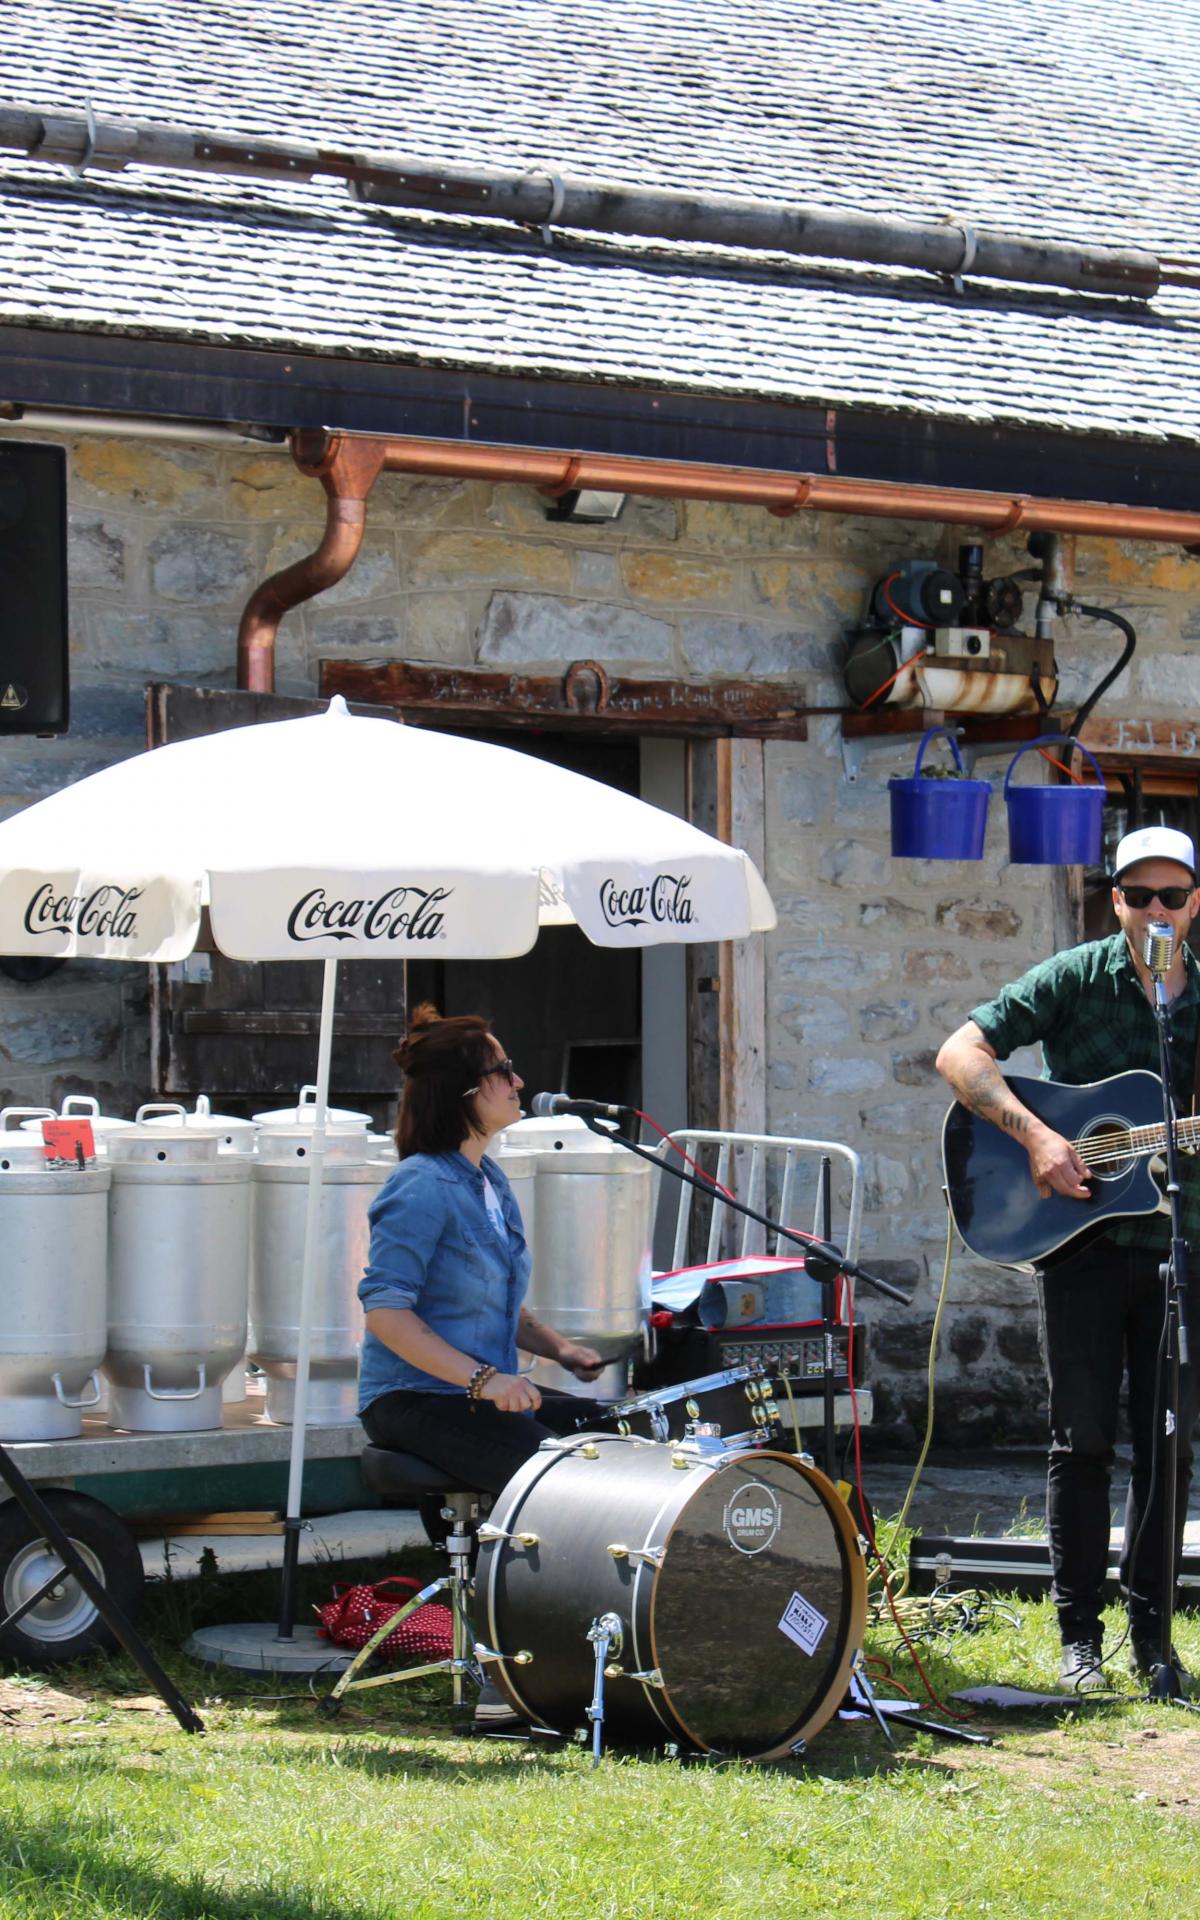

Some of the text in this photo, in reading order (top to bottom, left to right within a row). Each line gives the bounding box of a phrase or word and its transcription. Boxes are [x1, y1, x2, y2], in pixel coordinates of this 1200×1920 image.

[23, 883, 146, 938] Coca-Cola
[286, 886, 456, 942] Coca-Cola
[600, 874, 693, 928] Coca-Cola
[731, 1507, 774, 1527] GMS
[736, 1528, 755, 1537] DRUM
